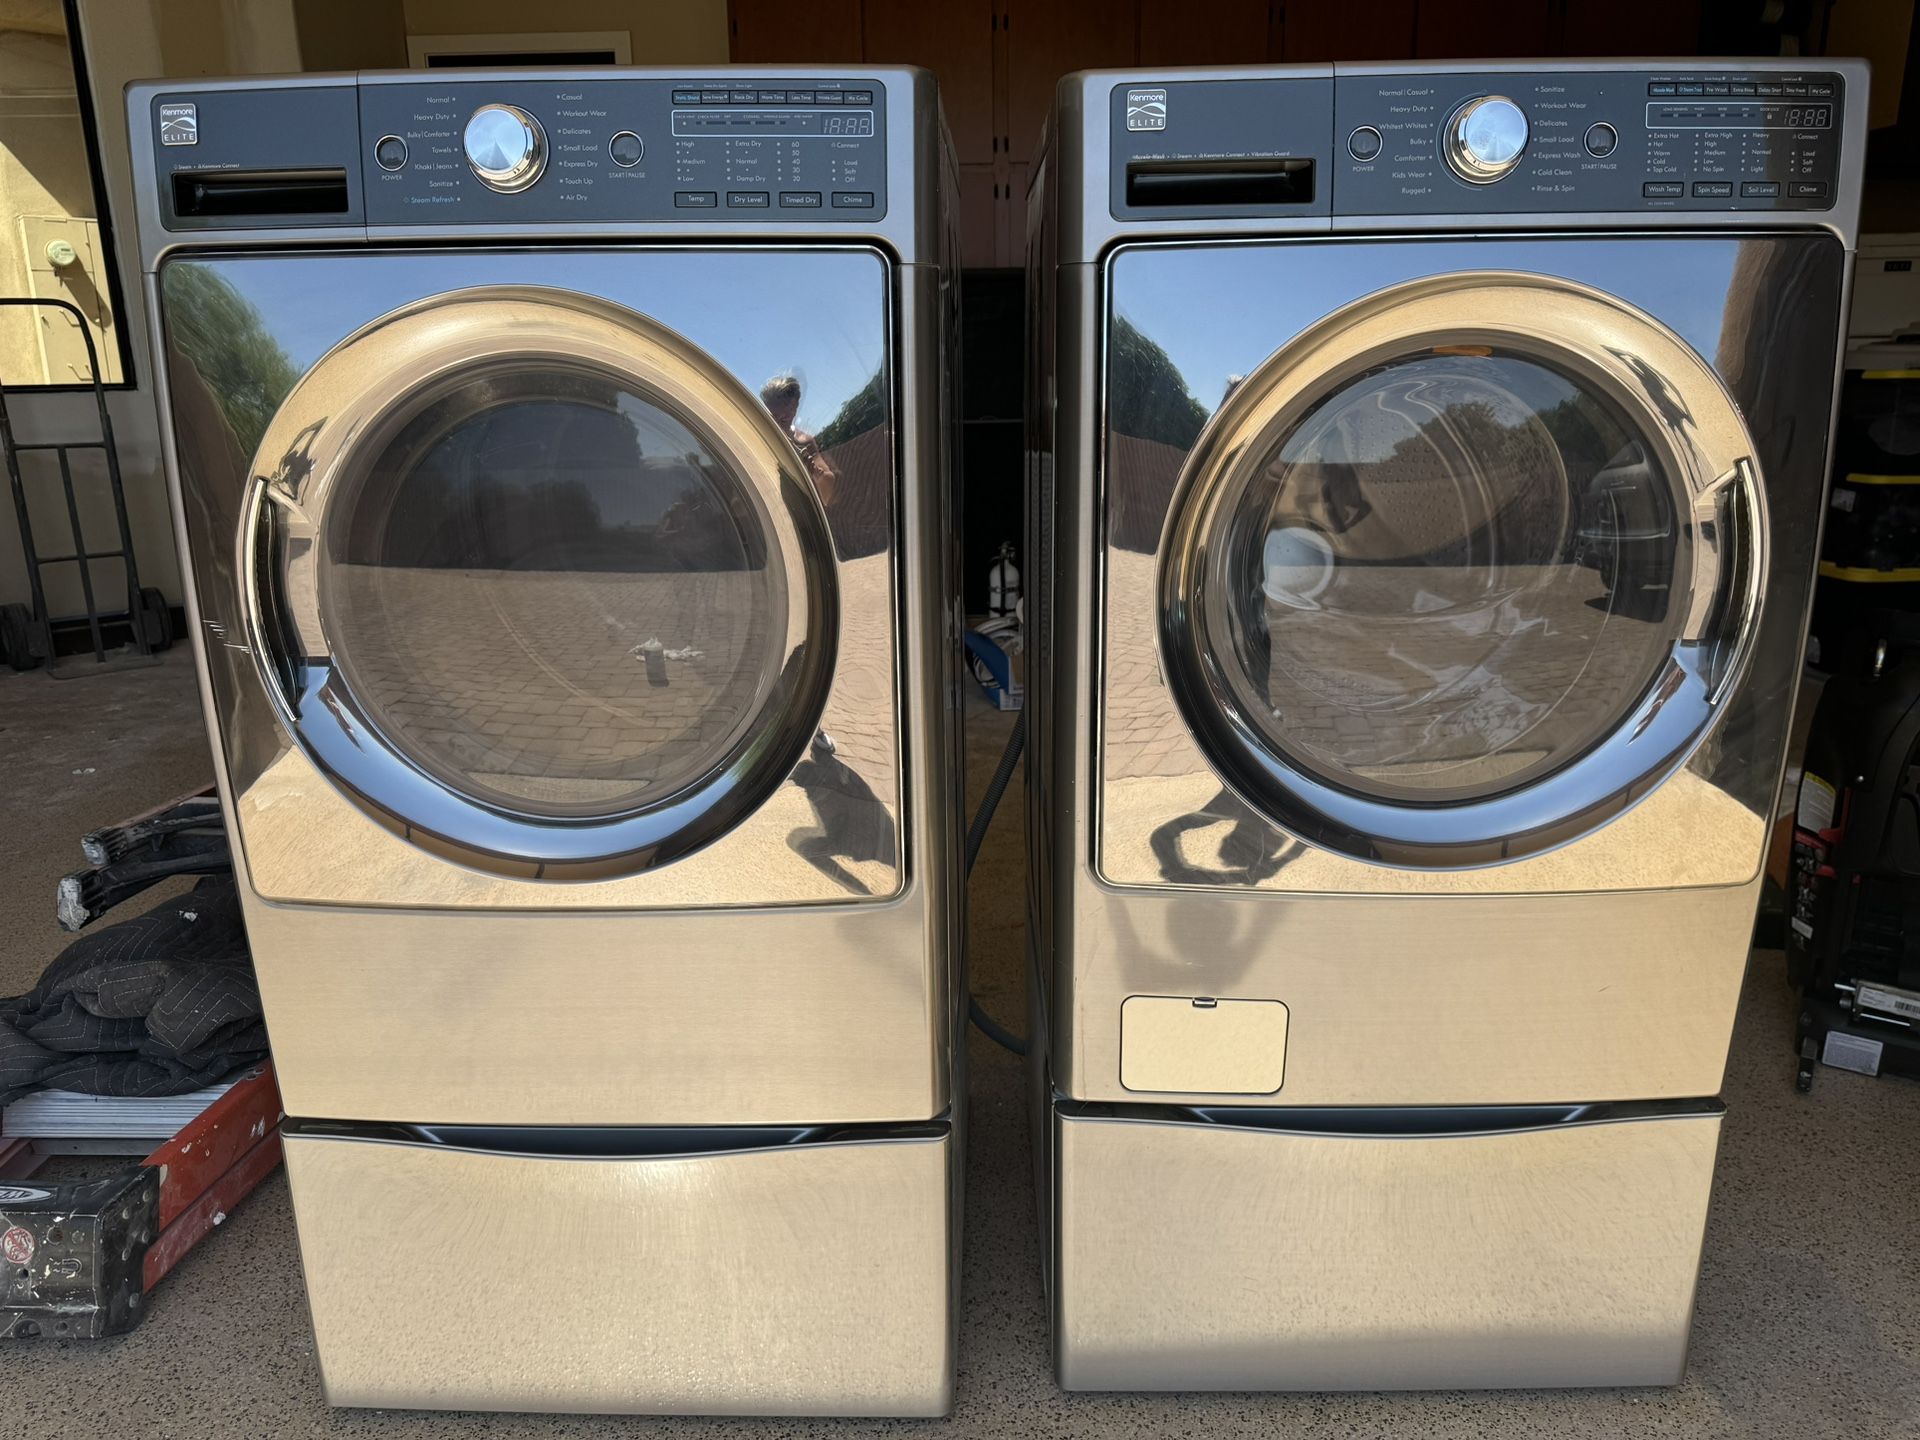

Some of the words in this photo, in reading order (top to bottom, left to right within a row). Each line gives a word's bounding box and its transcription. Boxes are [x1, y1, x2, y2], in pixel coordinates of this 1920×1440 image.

[745, 94, 754, 102] Dry
[1130, 94, 1164, 102] Kenmore
[1412, 105, 1427, 113] Duty
[1130, 119, 1162, 127] ELITE
[1410, 138, 1426, 146] Bulky
[1394, 154, 1426, 162] Comforter
[1538, 152, 1561, 160] Express
[563, 161, 585, 169] Express
[587, 160, 598, 169] Dry
[753, 175, 765, 183] Dry
[1392, 171, 1406, 179] Kids
[1402, 187, 1425, 195] Rugged
[1561, 185, 1575, 193] Spin
[688, 195, 704, 203] Temp
